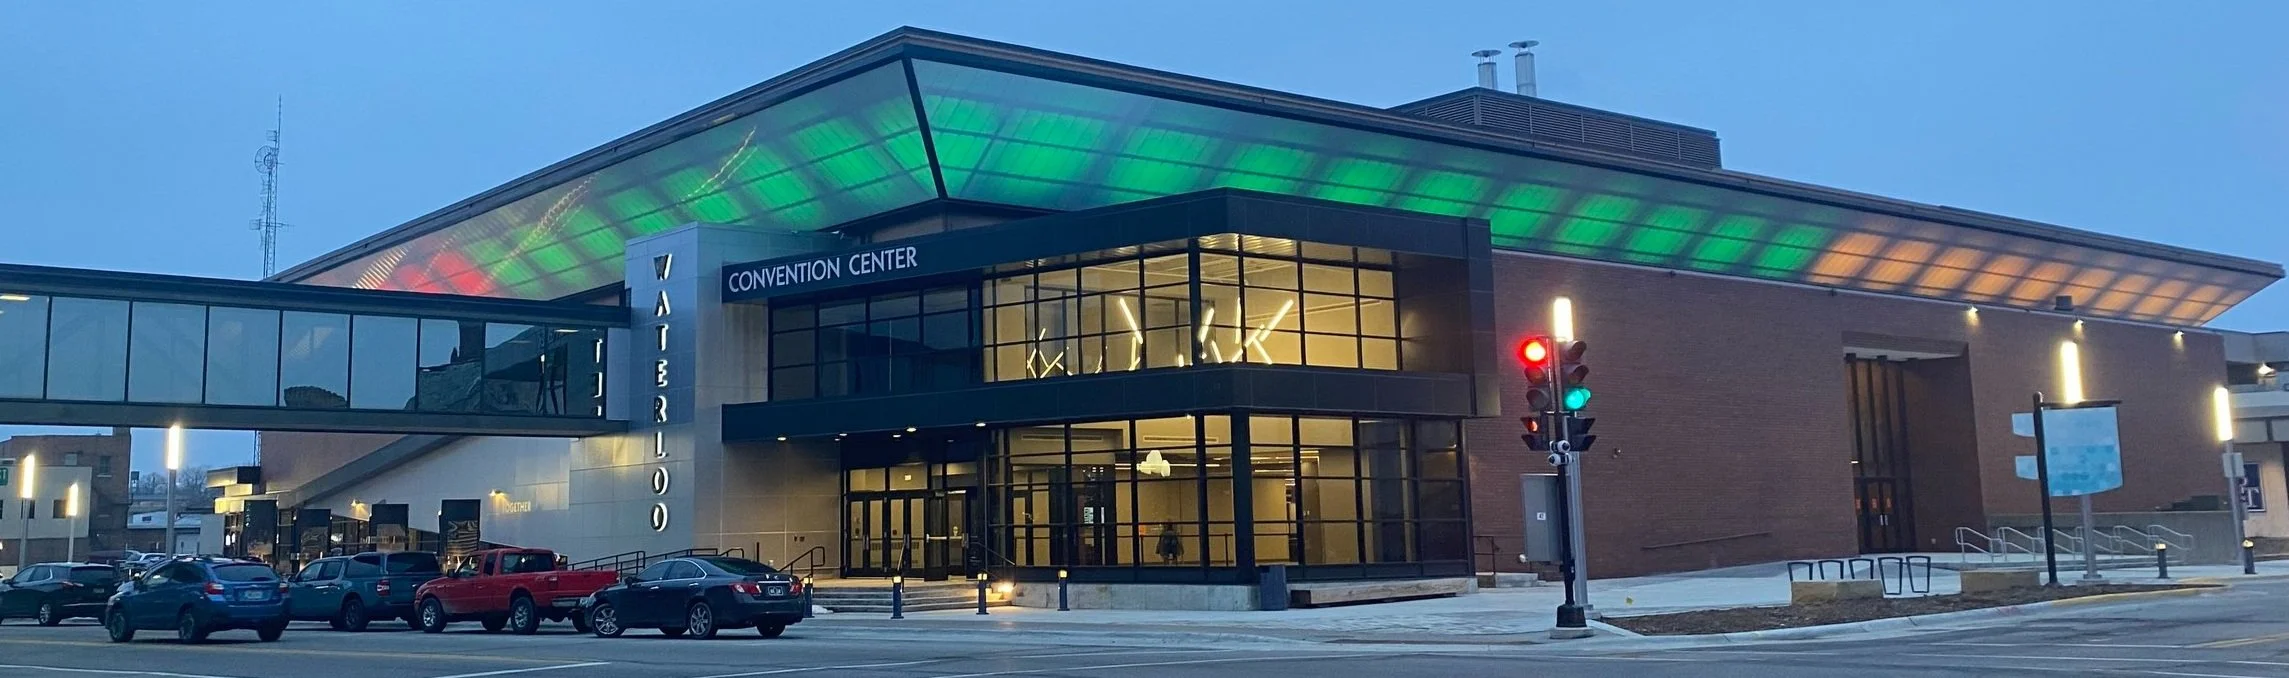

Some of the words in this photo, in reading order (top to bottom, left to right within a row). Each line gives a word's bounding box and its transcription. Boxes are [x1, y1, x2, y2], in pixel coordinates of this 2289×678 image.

[728, 257, 840, 293] CONVENTION
[849, 246, 918, 276] CENTER
[651, 253, 673, 533] WATERLOO
